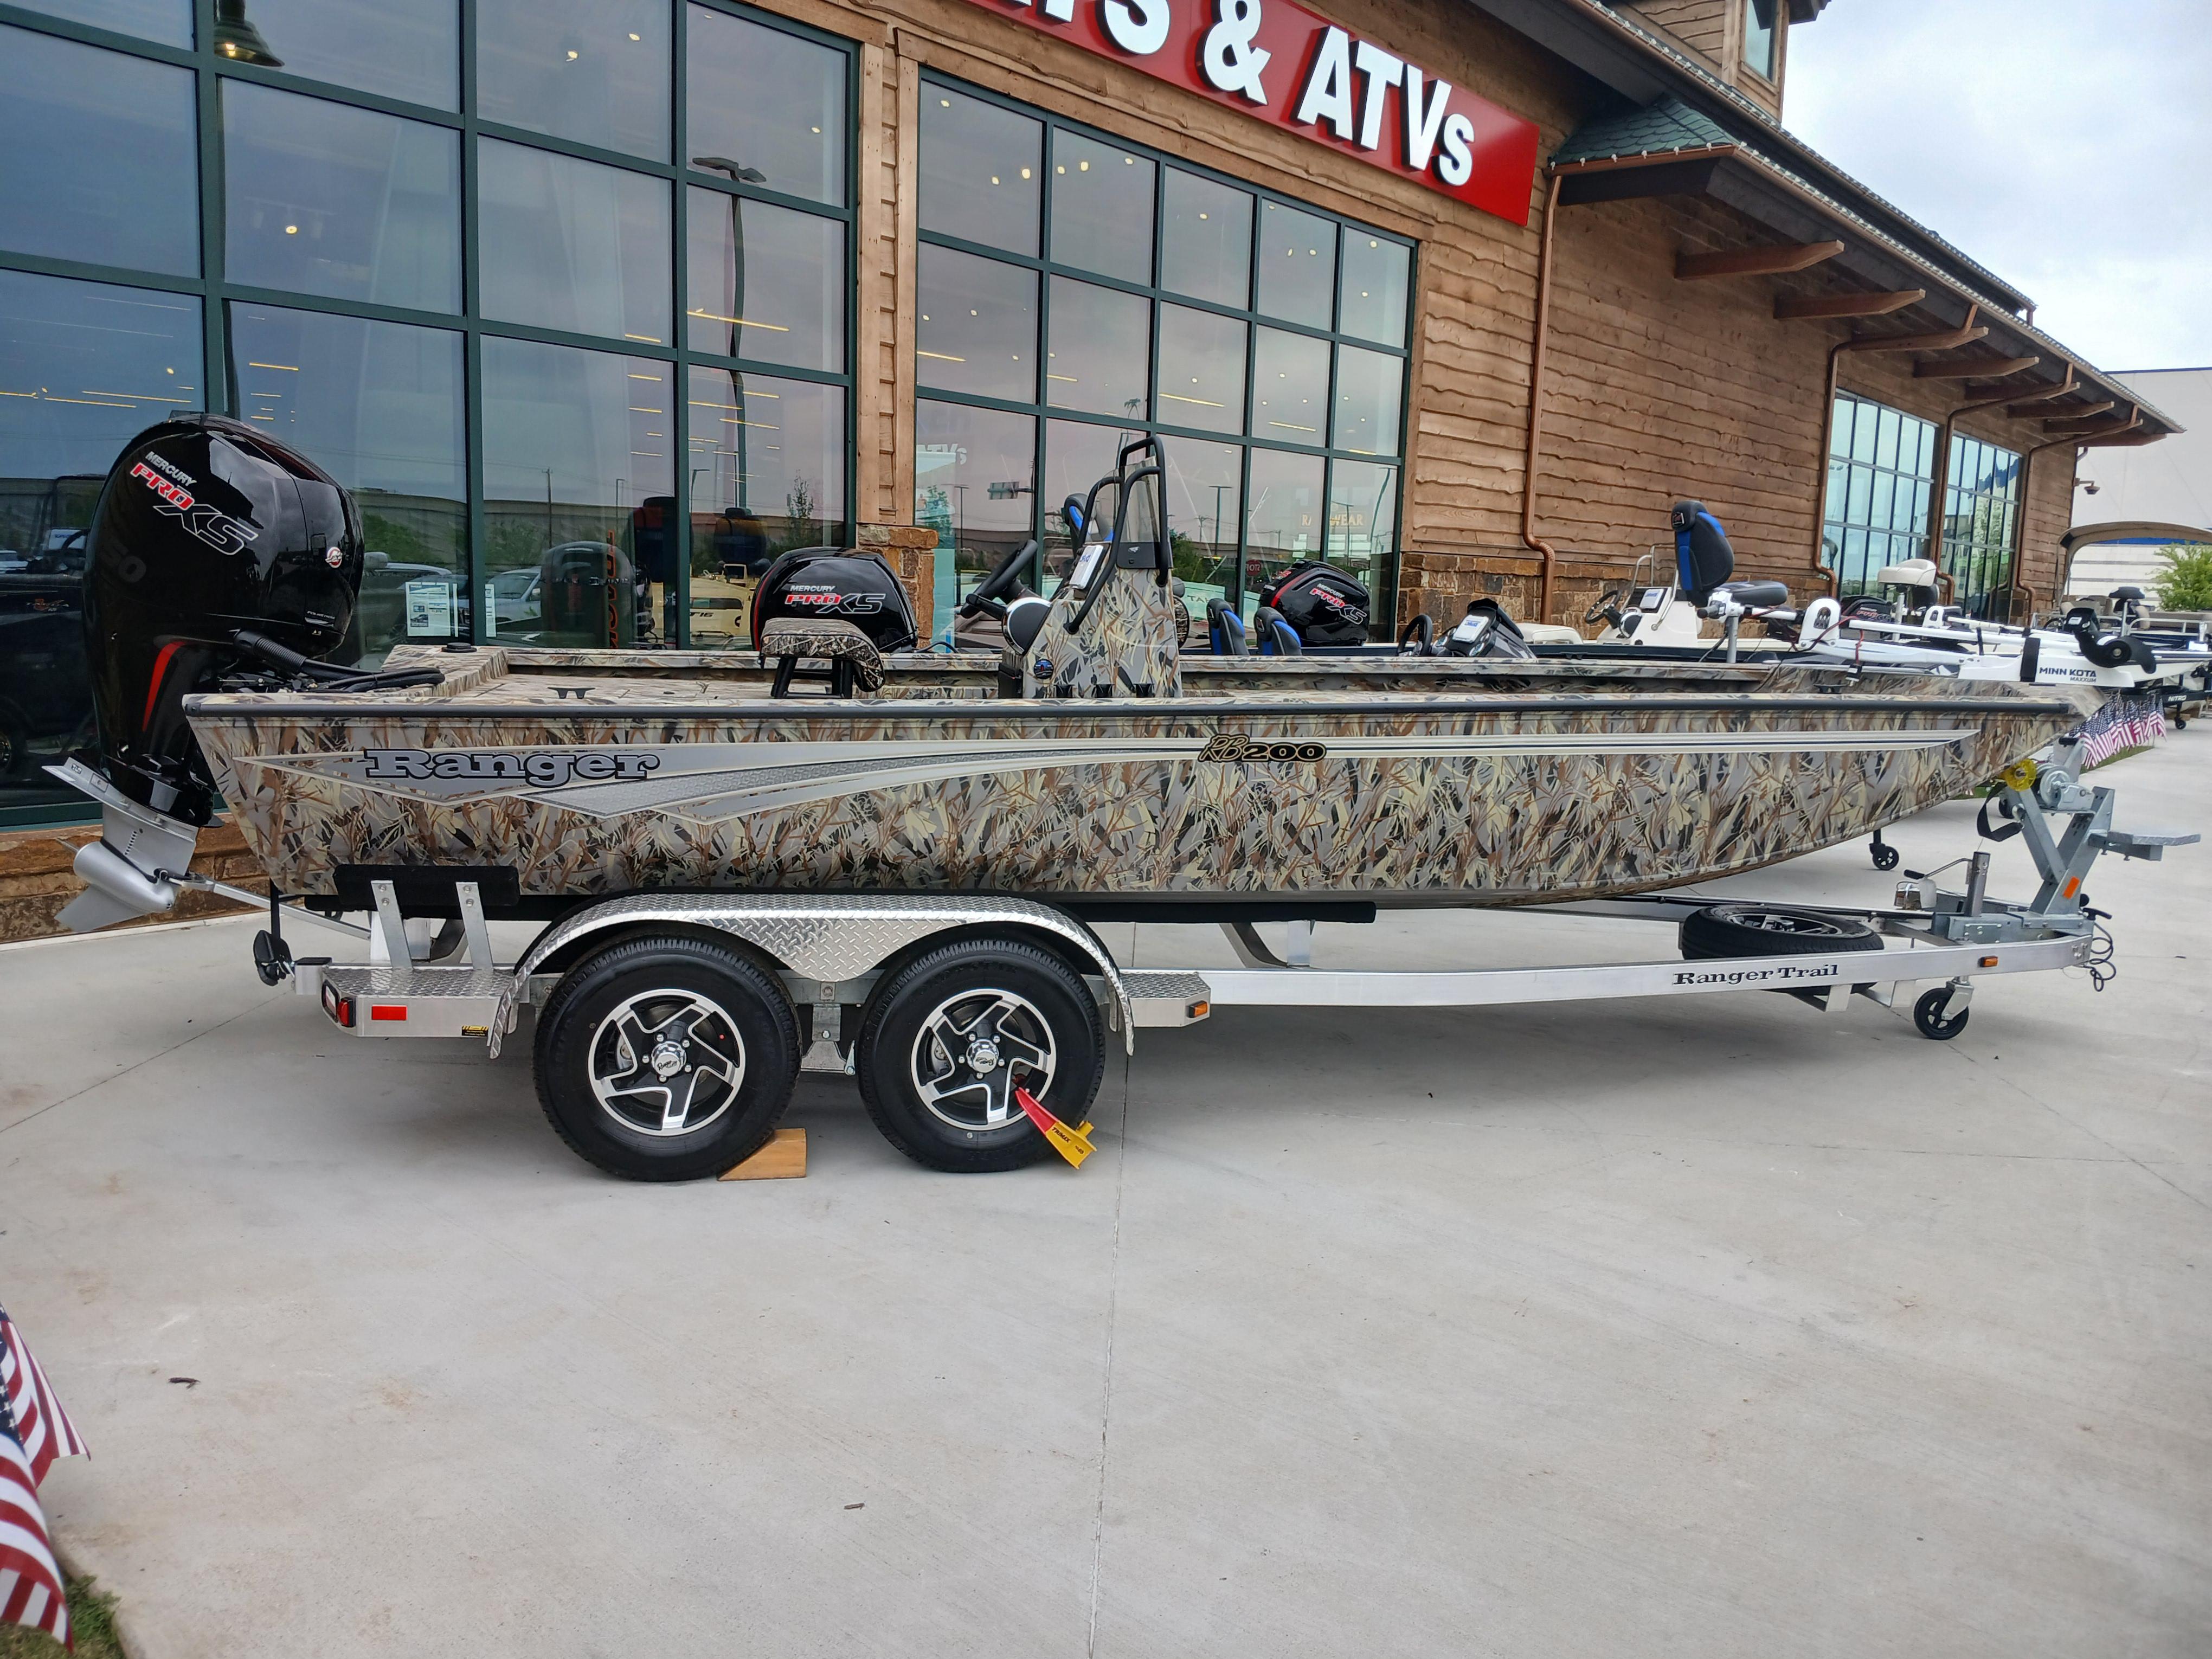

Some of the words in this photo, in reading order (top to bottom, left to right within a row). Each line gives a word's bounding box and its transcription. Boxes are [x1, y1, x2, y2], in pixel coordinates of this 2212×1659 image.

[1297, 25, 1475, 187] ATVs
[145, 451, 197, 486] MERCURY
[130, 462, 195, 511] PRO
[153, 504, 259, 561] XS
[785, 594, 841, 605] PRO
[815, 593, 886, 614] XS
[1309, 588, 1345, 608] PRO
[1325, 605, 1367, 625] XS
[2039, 667, 2067, 676] MINN
[2069, 668, 2097, 677] KOTA
[364, 749, 660, 788] Ranger
[1673, 970, 1773, 985] Ranger
[1777, 964, 1840, 979] Trail
[1052, 1127, 1072, 1143] TRIMAX
